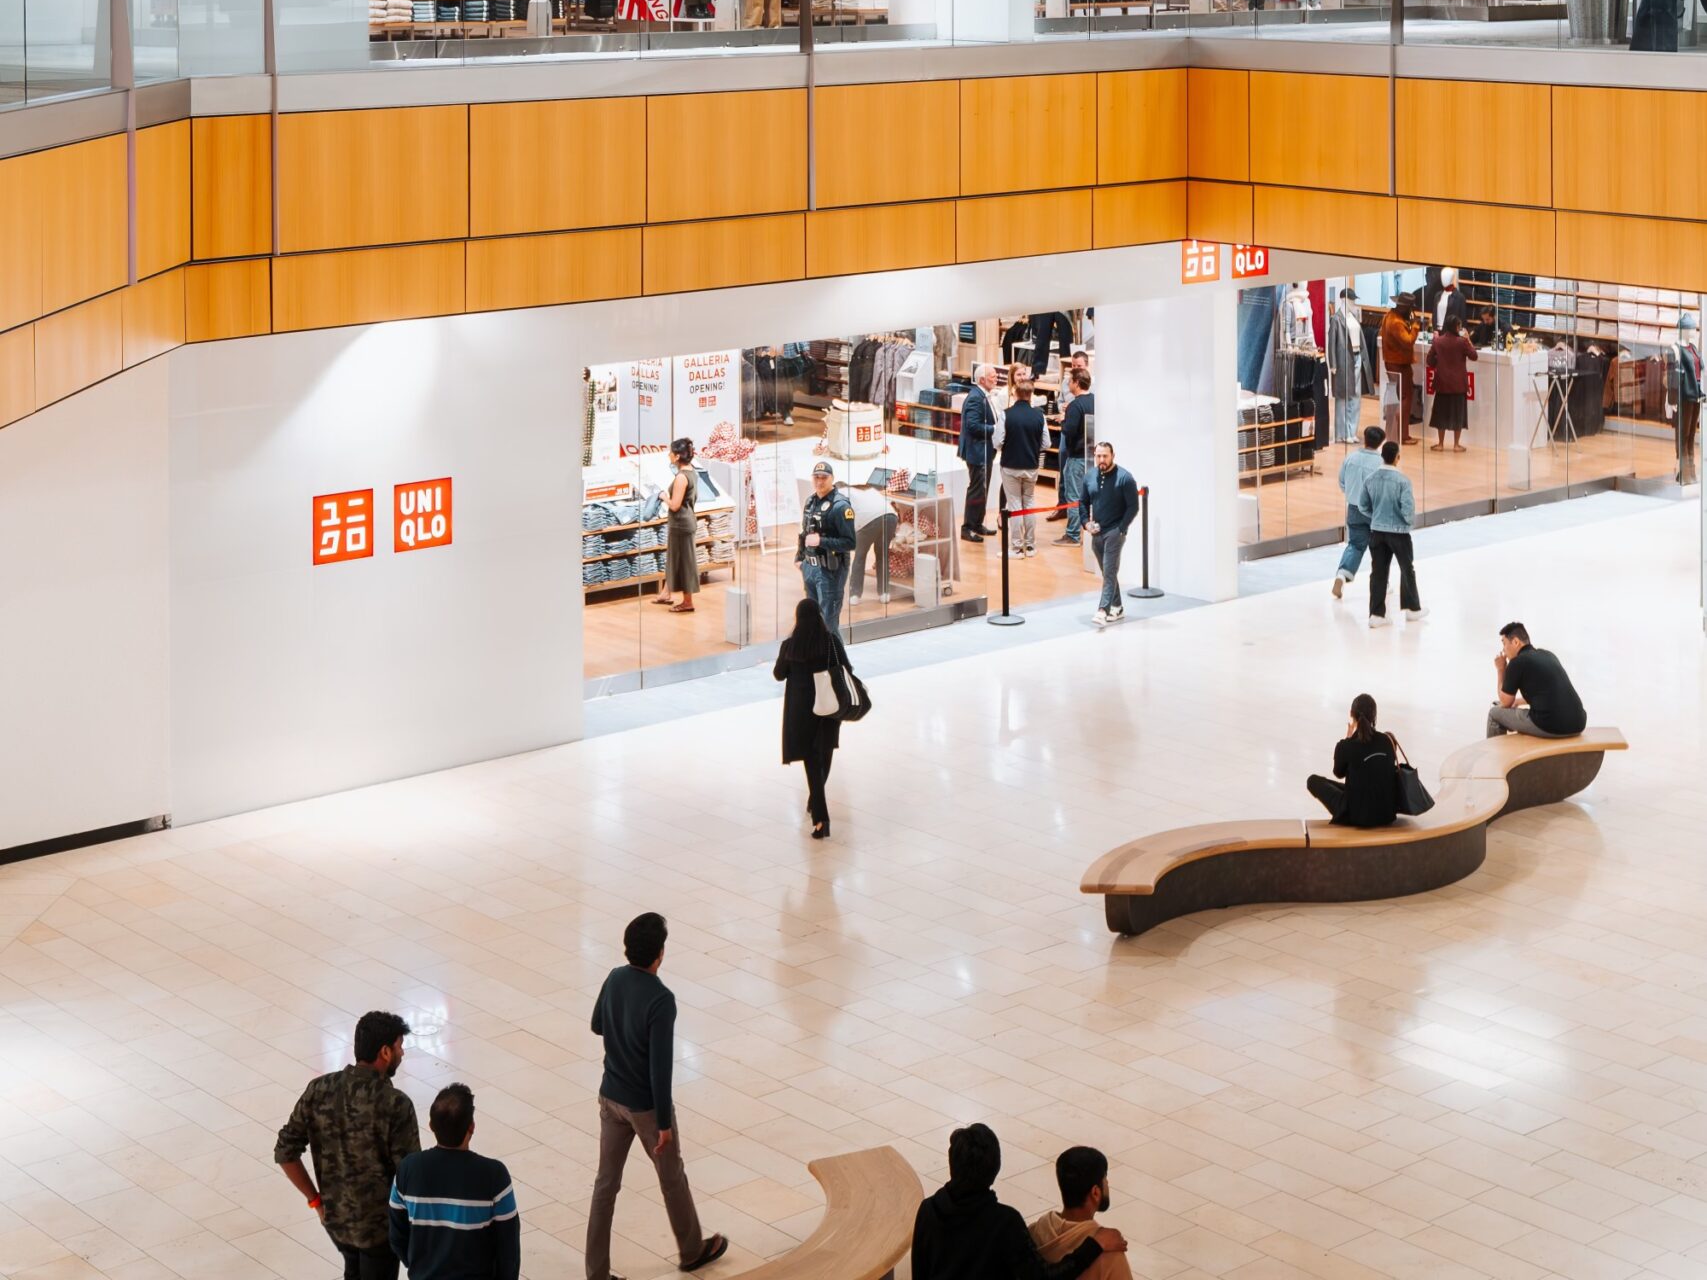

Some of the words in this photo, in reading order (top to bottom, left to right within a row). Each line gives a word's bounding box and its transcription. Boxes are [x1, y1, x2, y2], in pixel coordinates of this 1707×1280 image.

[1235, 250, 1265, 275] QLO
[684, 354, 730, 368] GALLERIA
[631, 366, 660, 381] DALLAS
[688, 367, 726, 382] DALLAS
[631, 380, 659, 393] OPENING!
[689, 381, 726, 394] OPENING!
[400, 486, 442, 516] UNI
[400, 514, 446, 547] QLO
